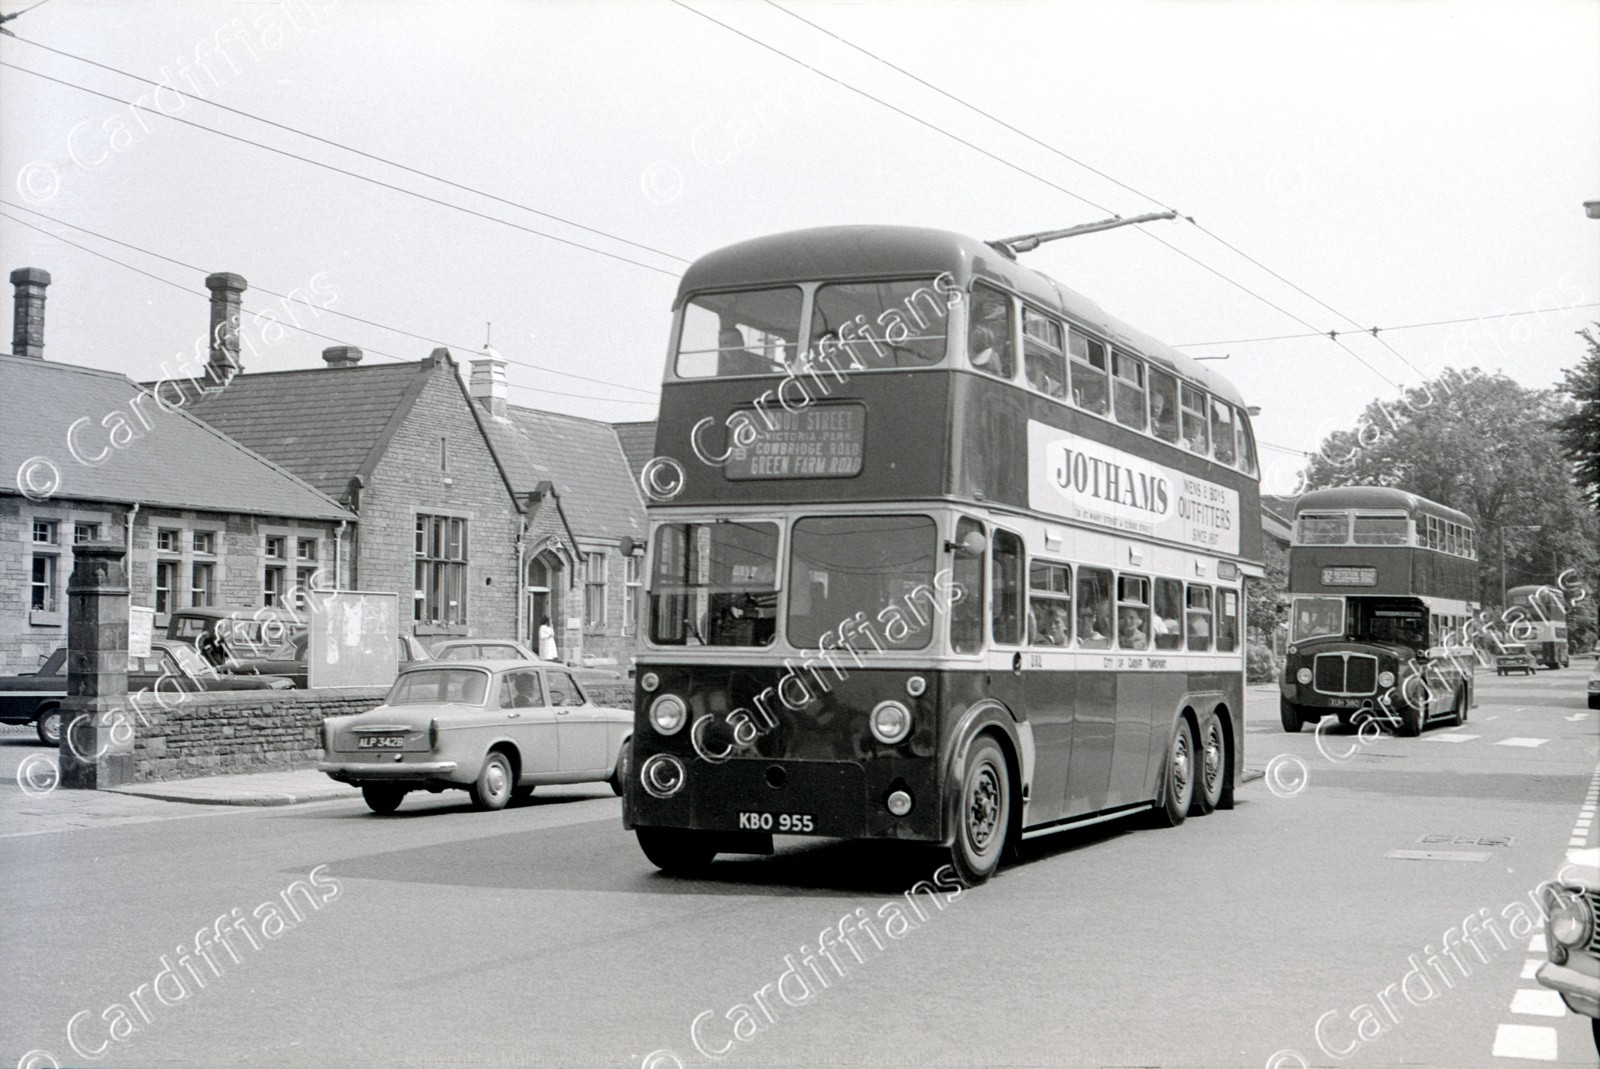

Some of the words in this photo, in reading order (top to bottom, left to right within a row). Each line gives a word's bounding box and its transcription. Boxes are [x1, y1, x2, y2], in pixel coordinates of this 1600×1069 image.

[807, 410, 852, 430] STREET
[756, 442, 823, 456] COWBRIDGE
[830, 442, 860, 456] ROAD
[751, 456, 789, 475] GREEN
[795, 456, 826, 474] FARM
[829, 456, 862, 473] ROAD
[1057, 447, 1168, 515] JOTHAMS
[1178, 496, 1231, 530] OUTFITTERS
[1192, 528, 1207, 543] SINCE
[359, 737, 376, 748] ALP
[377, 736, 404, 748] 342B
[739, 812, 773, 830] KBO
[778, 813, 814, 832] 955
